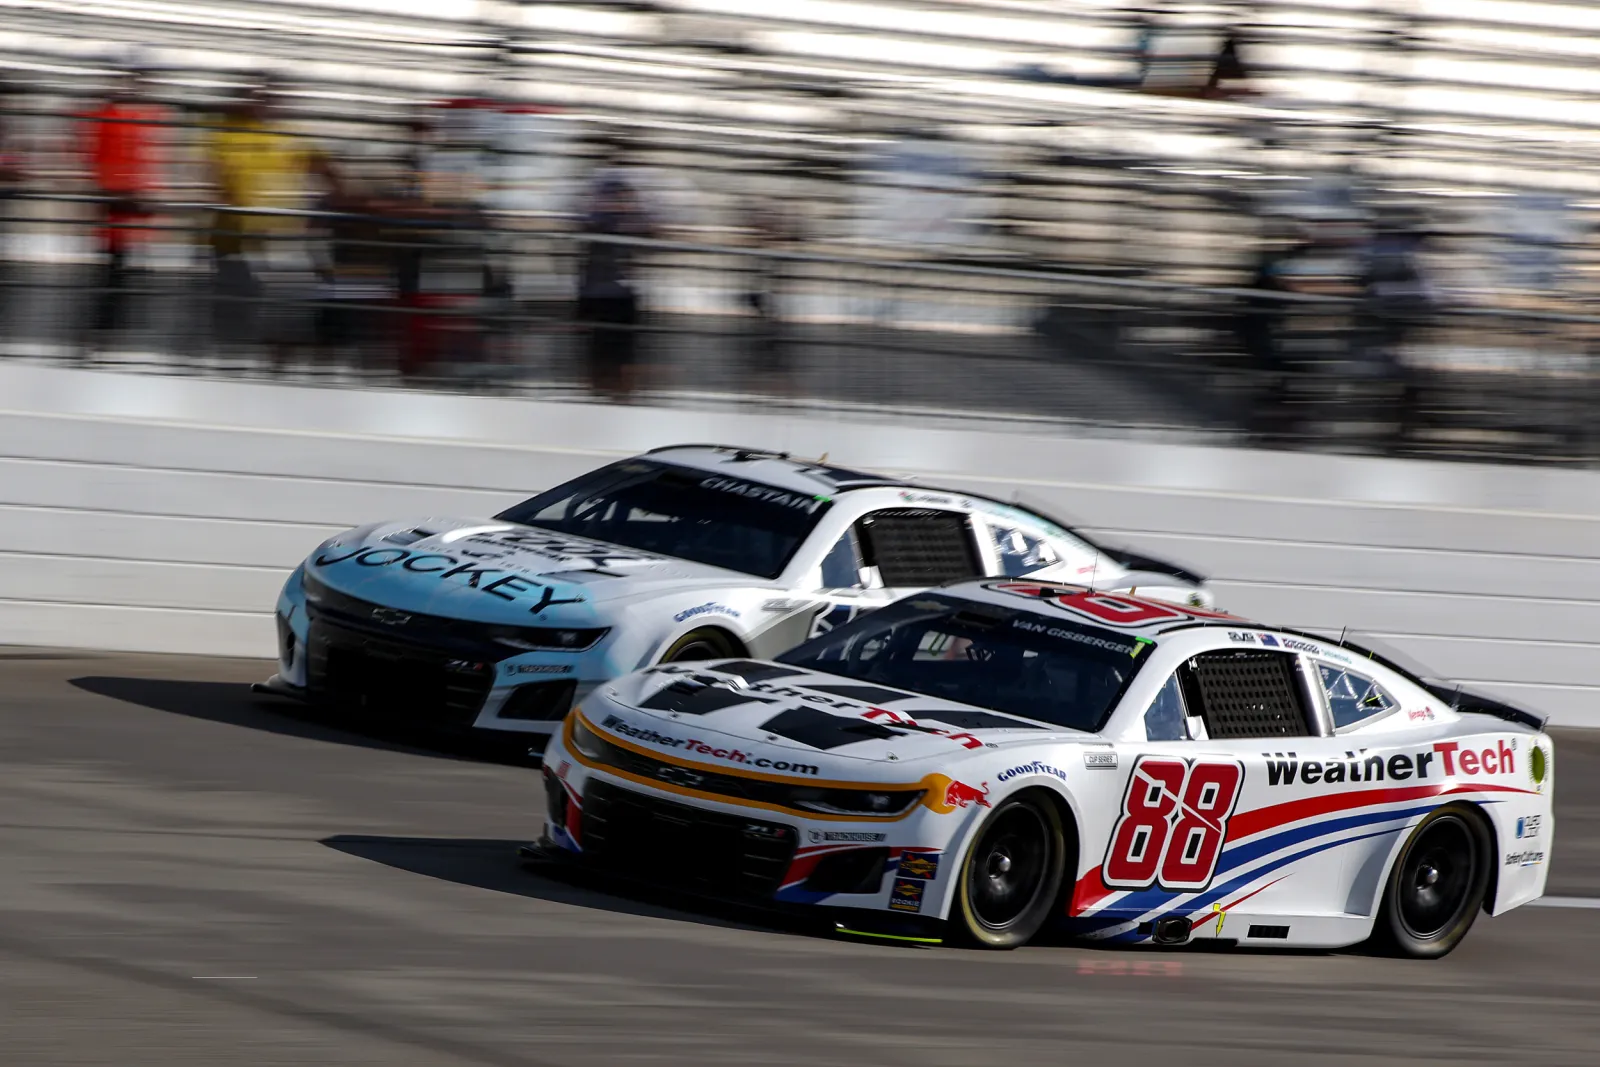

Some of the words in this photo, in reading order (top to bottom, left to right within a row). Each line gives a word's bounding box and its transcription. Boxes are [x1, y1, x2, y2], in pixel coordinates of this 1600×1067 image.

[699, 477, 824, 515] CHASTAIN
[314, 545, 588, 615] JOCKEY
[1012, 619, 1047, 633] VAN
[1046, 627, 1139, 656] GISBERGEN
[600, 713, 819, 775] WeatherTech.com
[1262, 739, 1515, 786] WeatherTech
[997, 760, 1067, 782] GOODYEAR
[1102, 754, 1245, 893] 88
